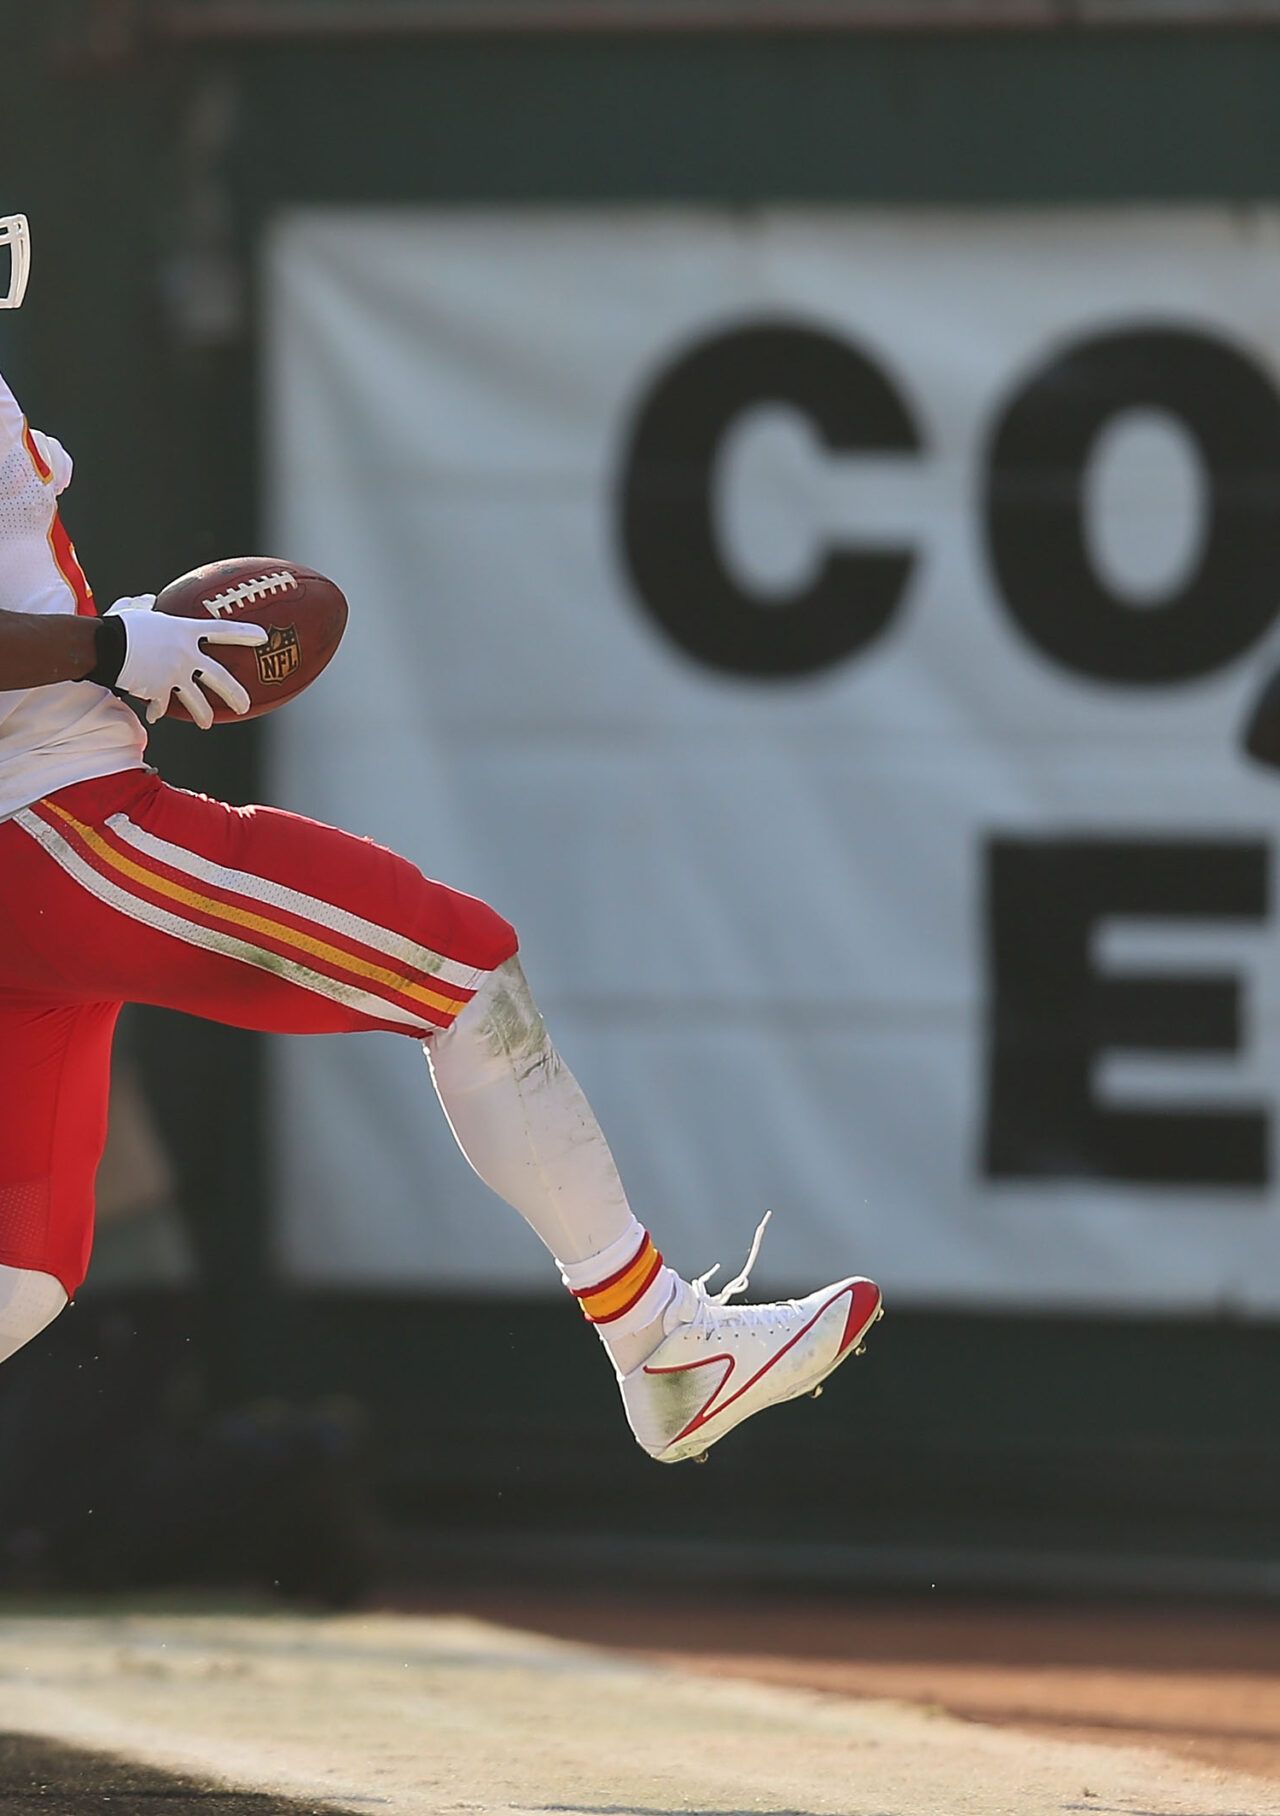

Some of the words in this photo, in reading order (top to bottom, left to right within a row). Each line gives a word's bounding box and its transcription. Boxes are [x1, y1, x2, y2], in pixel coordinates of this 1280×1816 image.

[262, 647, 298, 679] NFL
[615, 312, 1280, 692] CO
[981, 835, 1273, 1187] E
